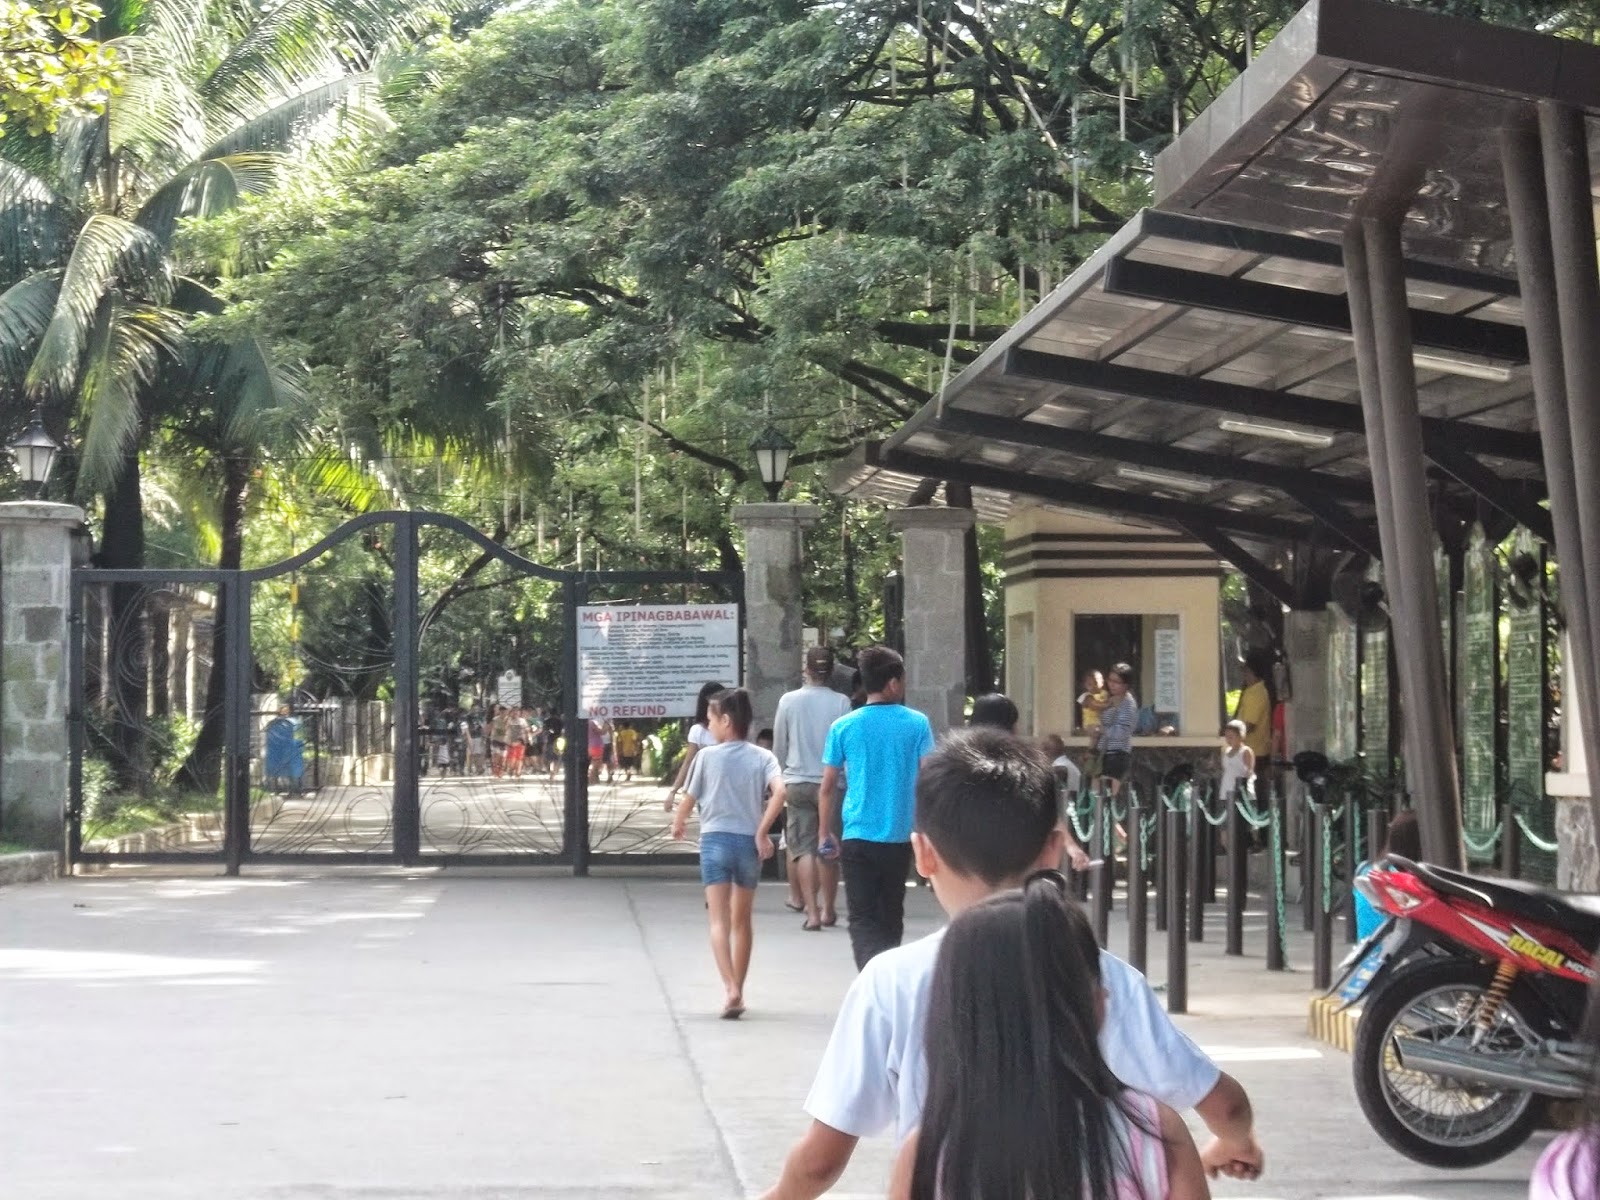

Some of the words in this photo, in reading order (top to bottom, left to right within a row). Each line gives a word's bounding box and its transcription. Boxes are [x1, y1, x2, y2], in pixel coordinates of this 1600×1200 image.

[582, 611, 612, 622] MGA
[616, 610, 735, 622] IPINAGBABAWAL:
[589, 706, 608, 717] NO
[613, 705, 666, 716] REFUND
